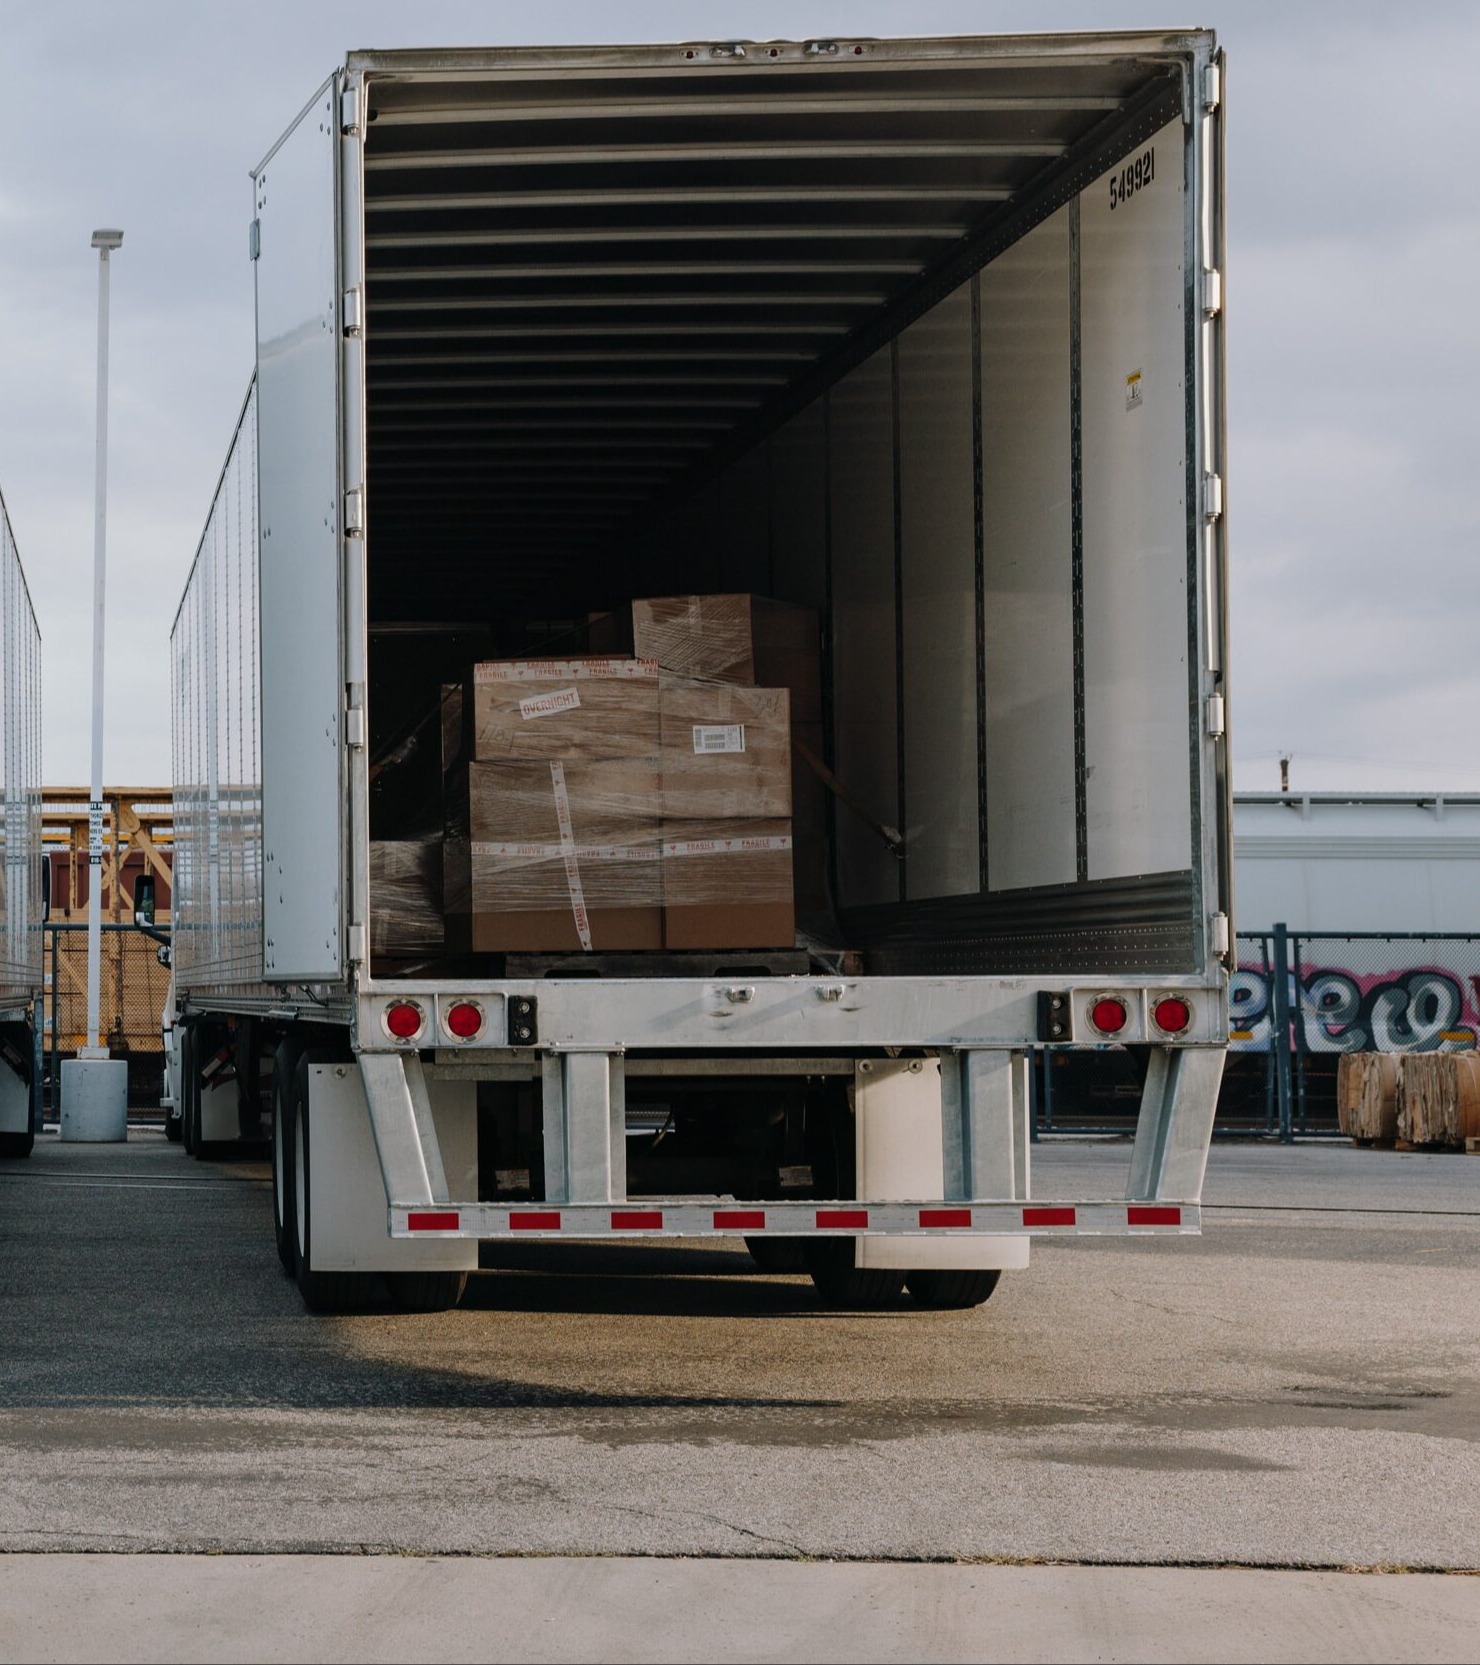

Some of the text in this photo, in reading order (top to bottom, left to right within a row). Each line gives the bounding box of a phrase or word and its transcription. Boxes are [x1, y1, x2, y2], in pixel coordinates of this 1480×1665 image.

[1110, 146, 1155, 211] 549921
[523, 692, 575, 715] OVERNIGHT
[686, 838, 770, 851] FRAGILE FRAGILE
[575, 904, 586, 932] FRAGILE
